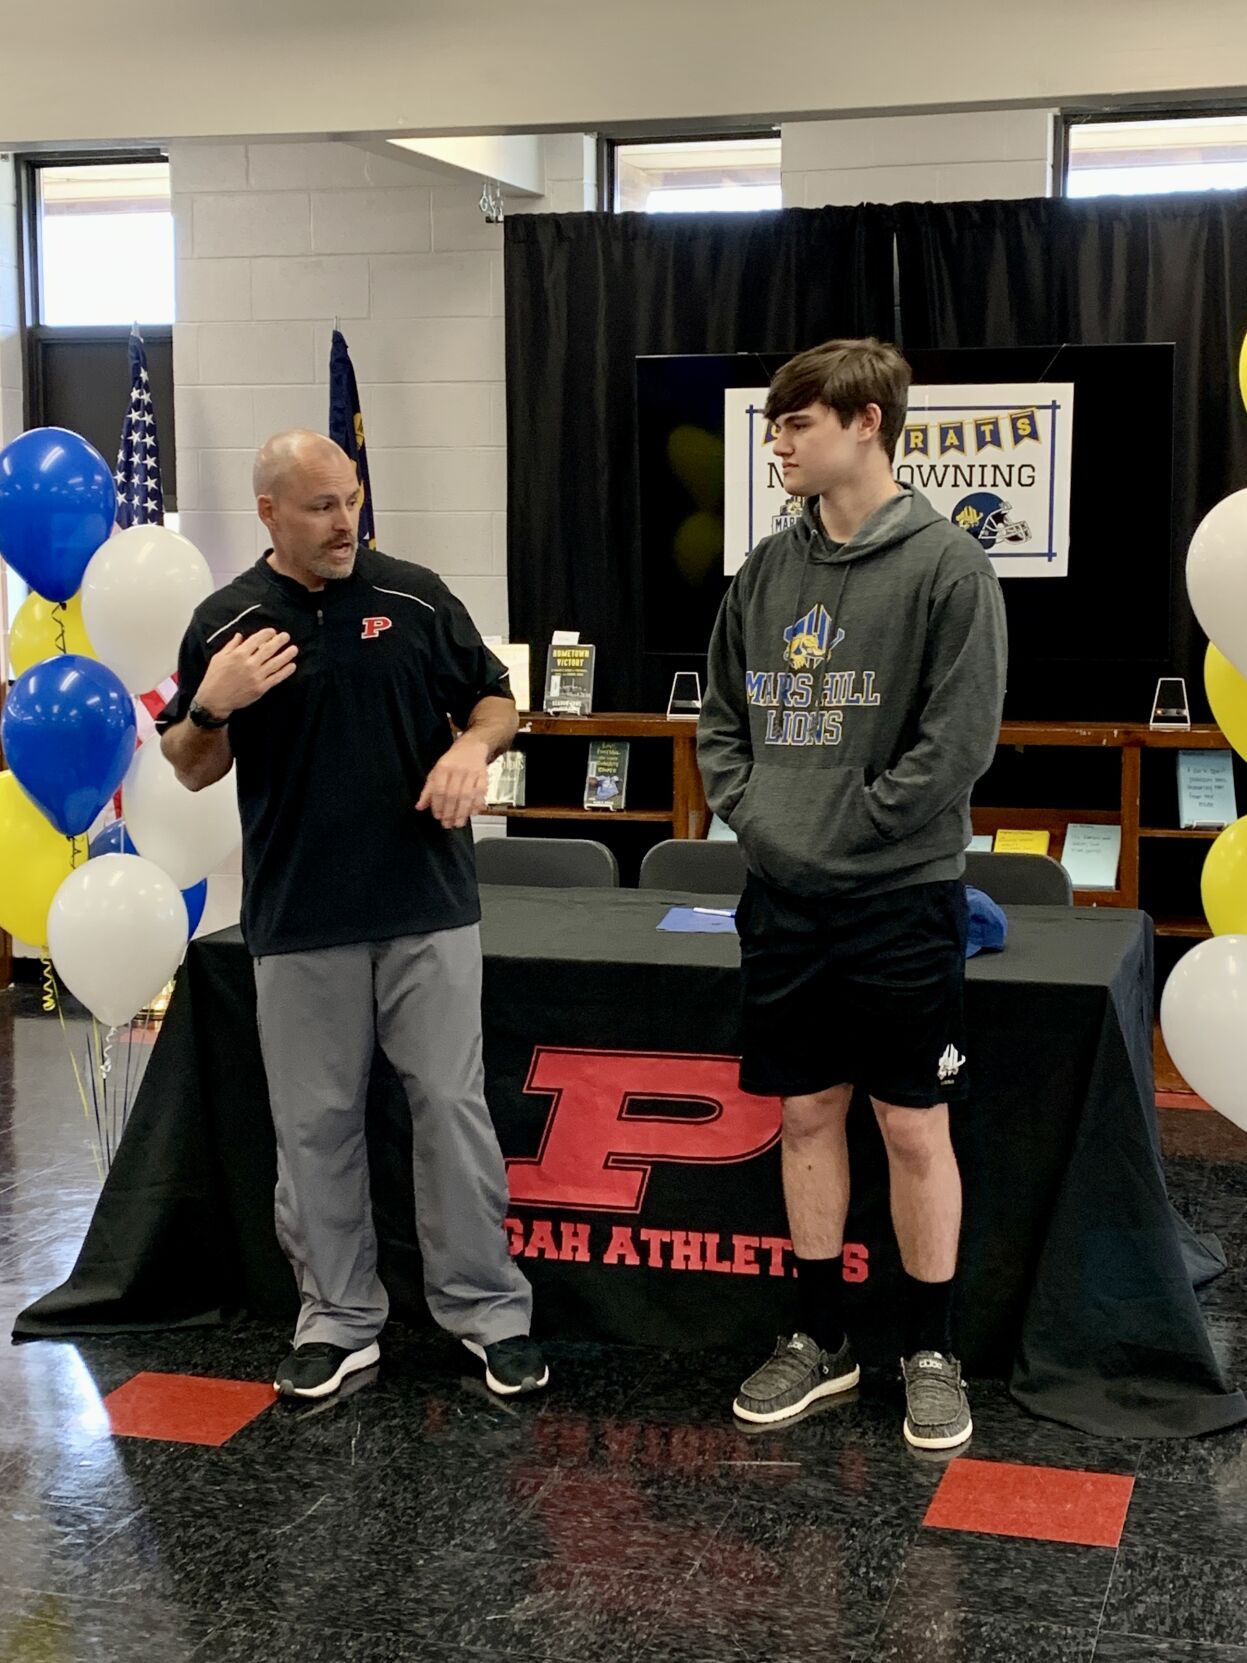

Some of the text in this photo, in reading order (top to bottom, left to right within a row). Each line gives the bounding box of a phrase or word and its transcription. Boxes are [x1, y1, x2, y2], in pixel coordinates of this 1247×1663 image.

[897, 463, 1036, 488] OWNING
[361, 616, 392, 639] P
[557, 659, 584, 667] VICTORY
[746, 671, 881, 707] MARS HILL
[765, 710, 843, 746] LIONS
[505, 1045, 783, 1214] P
[504, 1218, 870, 1283] GAH ATHLETS
